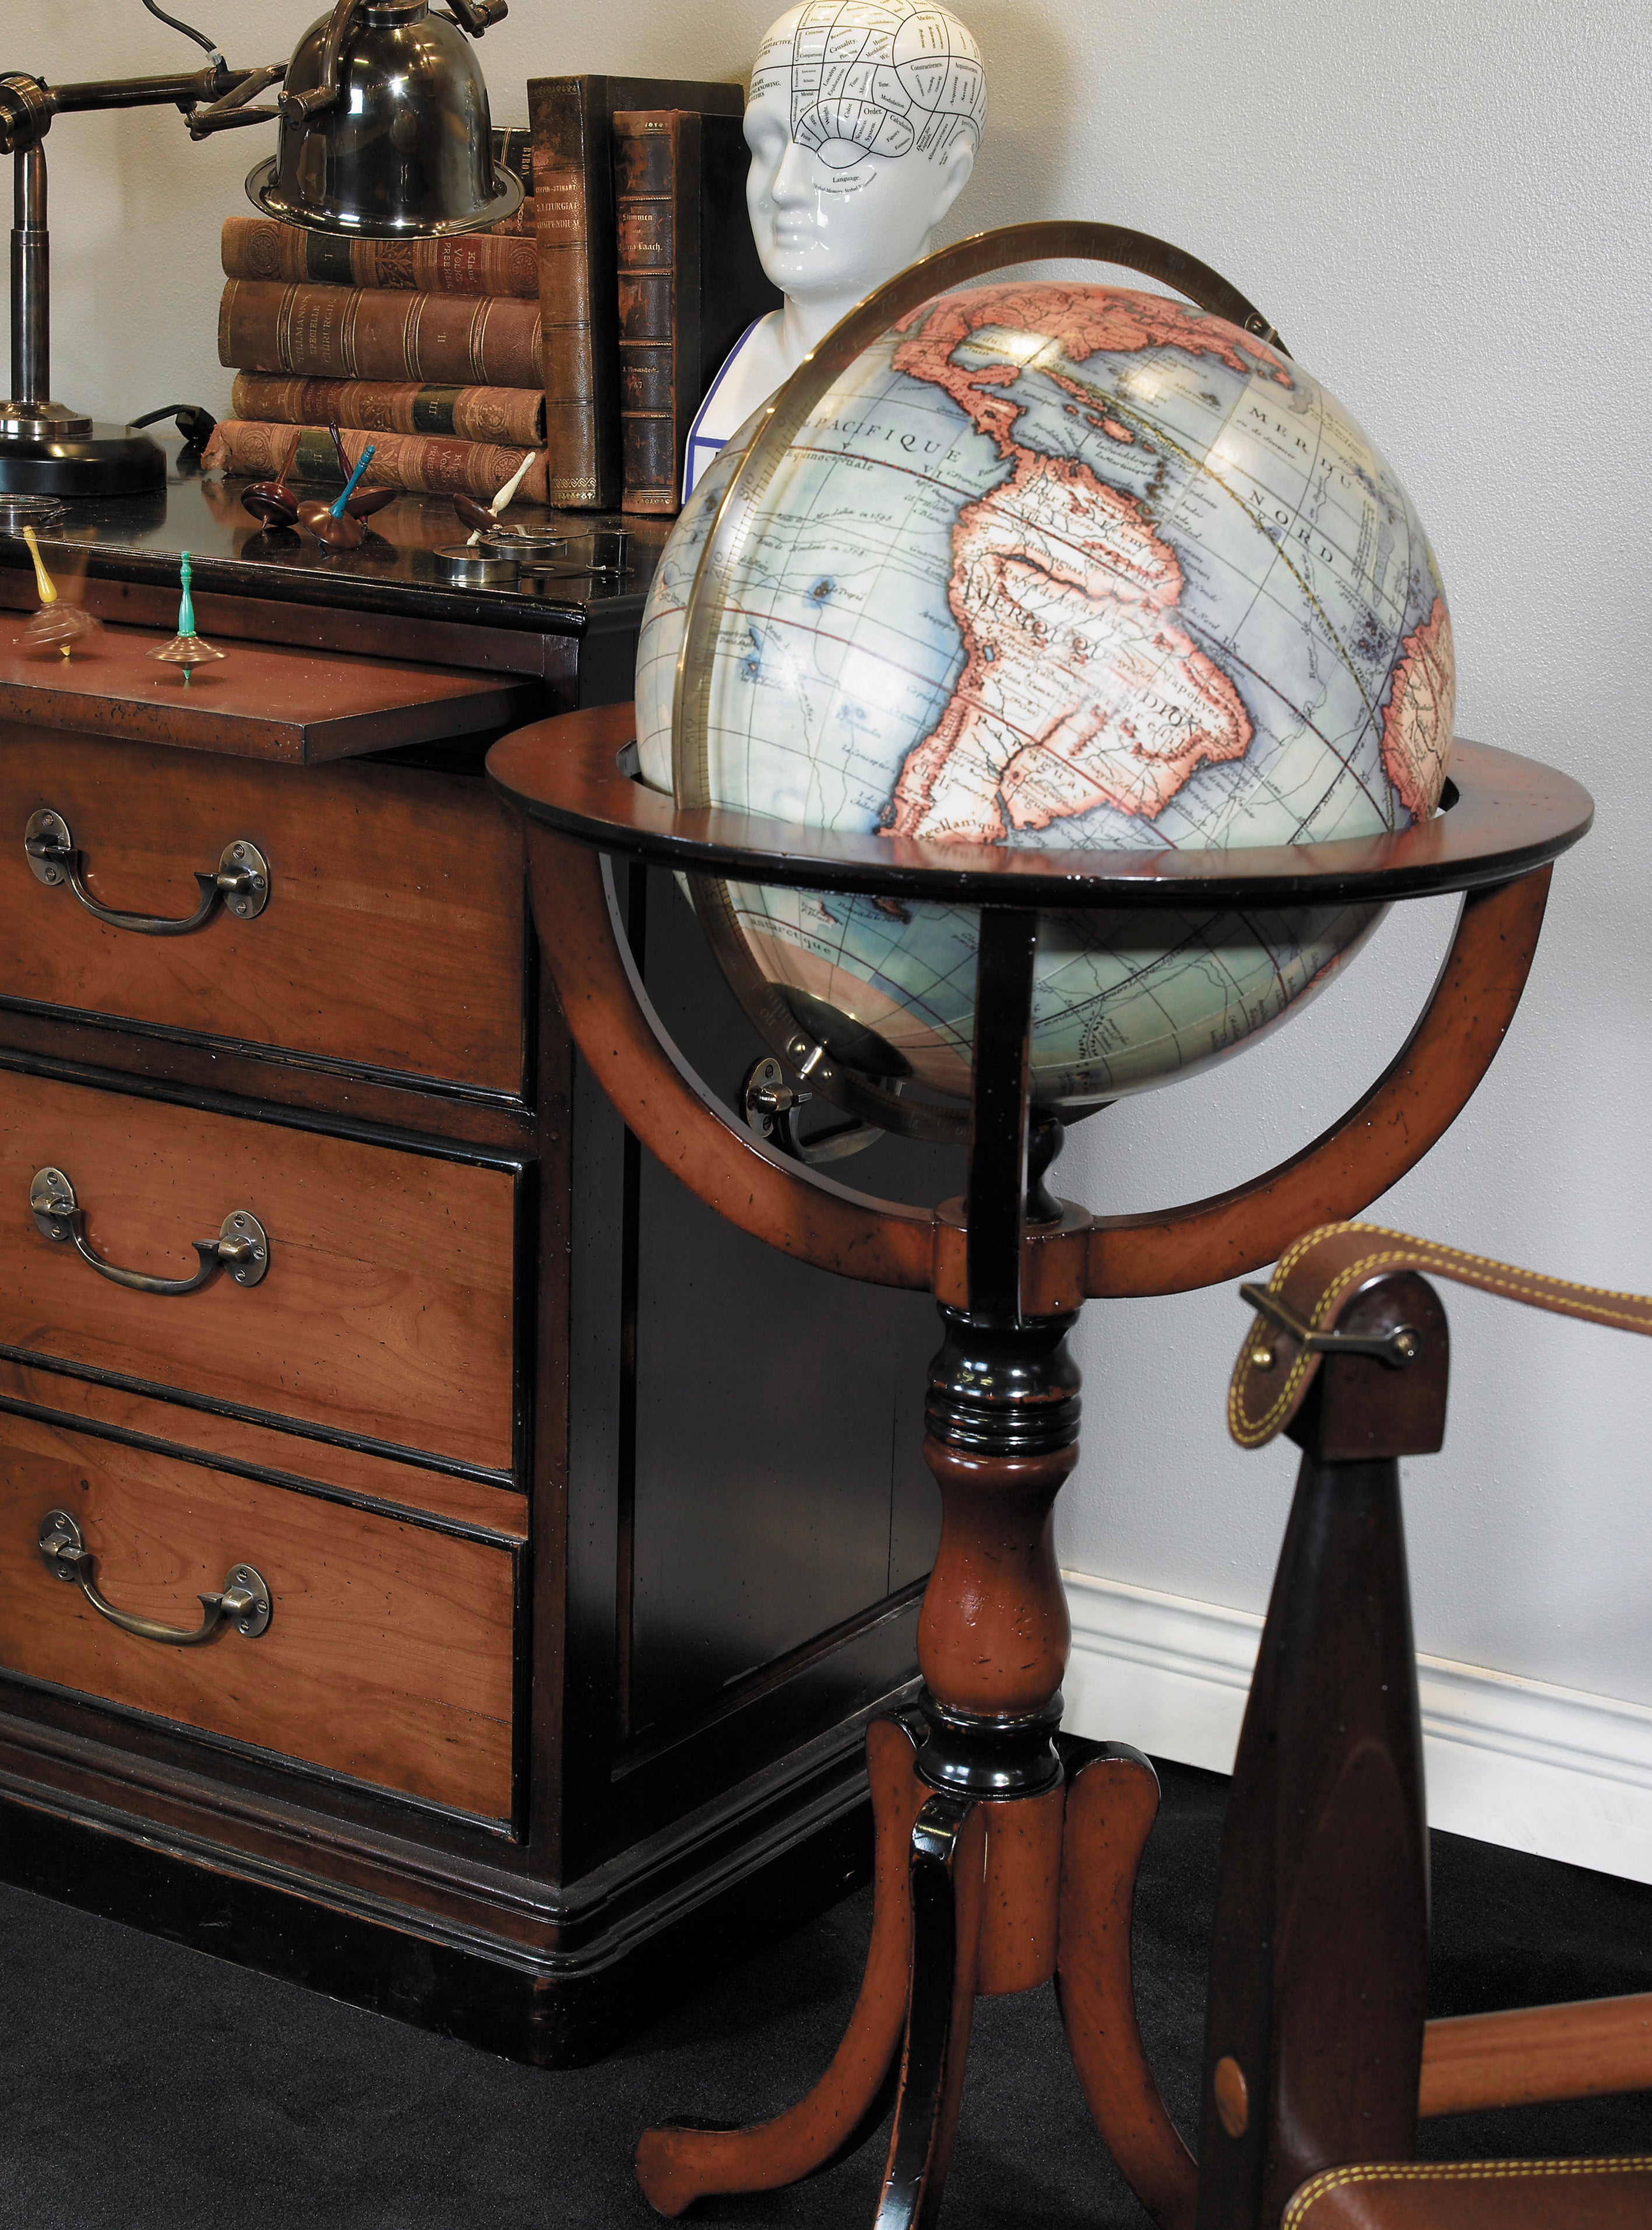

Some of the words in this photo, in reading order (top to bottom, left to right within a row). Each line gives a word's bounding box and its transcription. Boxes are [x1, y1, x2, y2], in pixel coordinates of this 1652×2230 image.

[829, 38, 858, 54] Causality.
[823, 65, 837, 86] Locality.
[844, 103, 853, 118] Color.
[815, 417, 961, 464] PACIFIQUE
[1250, 489, 1333, 563] NORD
